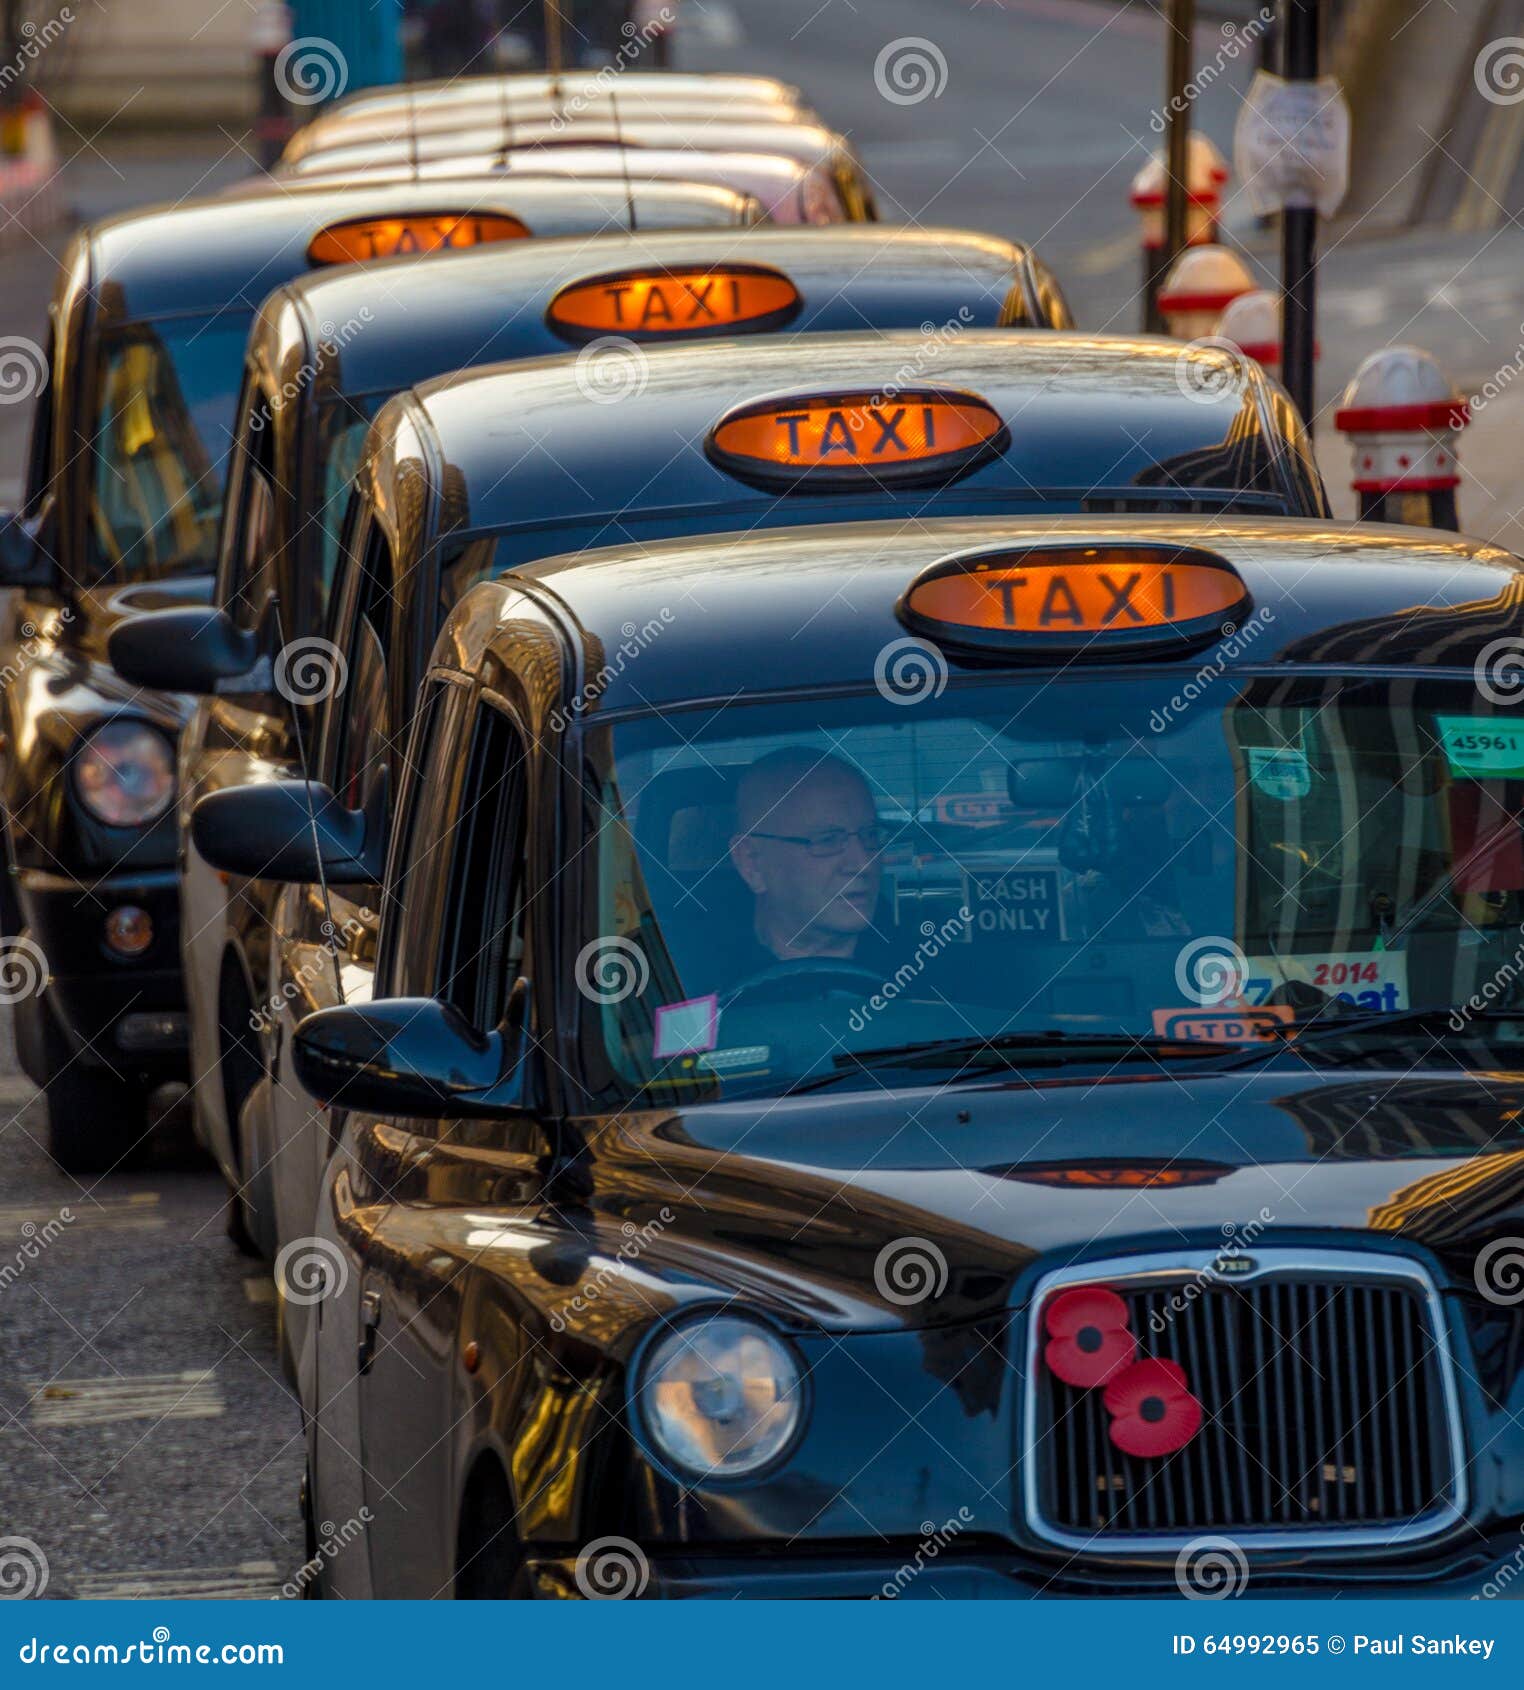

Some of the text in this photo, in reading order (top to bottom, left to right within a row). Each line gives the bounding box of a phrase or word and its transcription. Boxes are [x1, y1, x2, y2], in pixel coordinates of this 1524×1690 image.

[605, 280, 741, 327] TAXI
[775, 408, 937, 456] TAXI
[986, 572, 1175, 627] TAXI
[1451, 735, 1517, 751] 45961
[976, 877, 1047, 901] CASH
[978, 908, 1050, 931] ONLY
[1313, 961, 1379, 986] 2014
